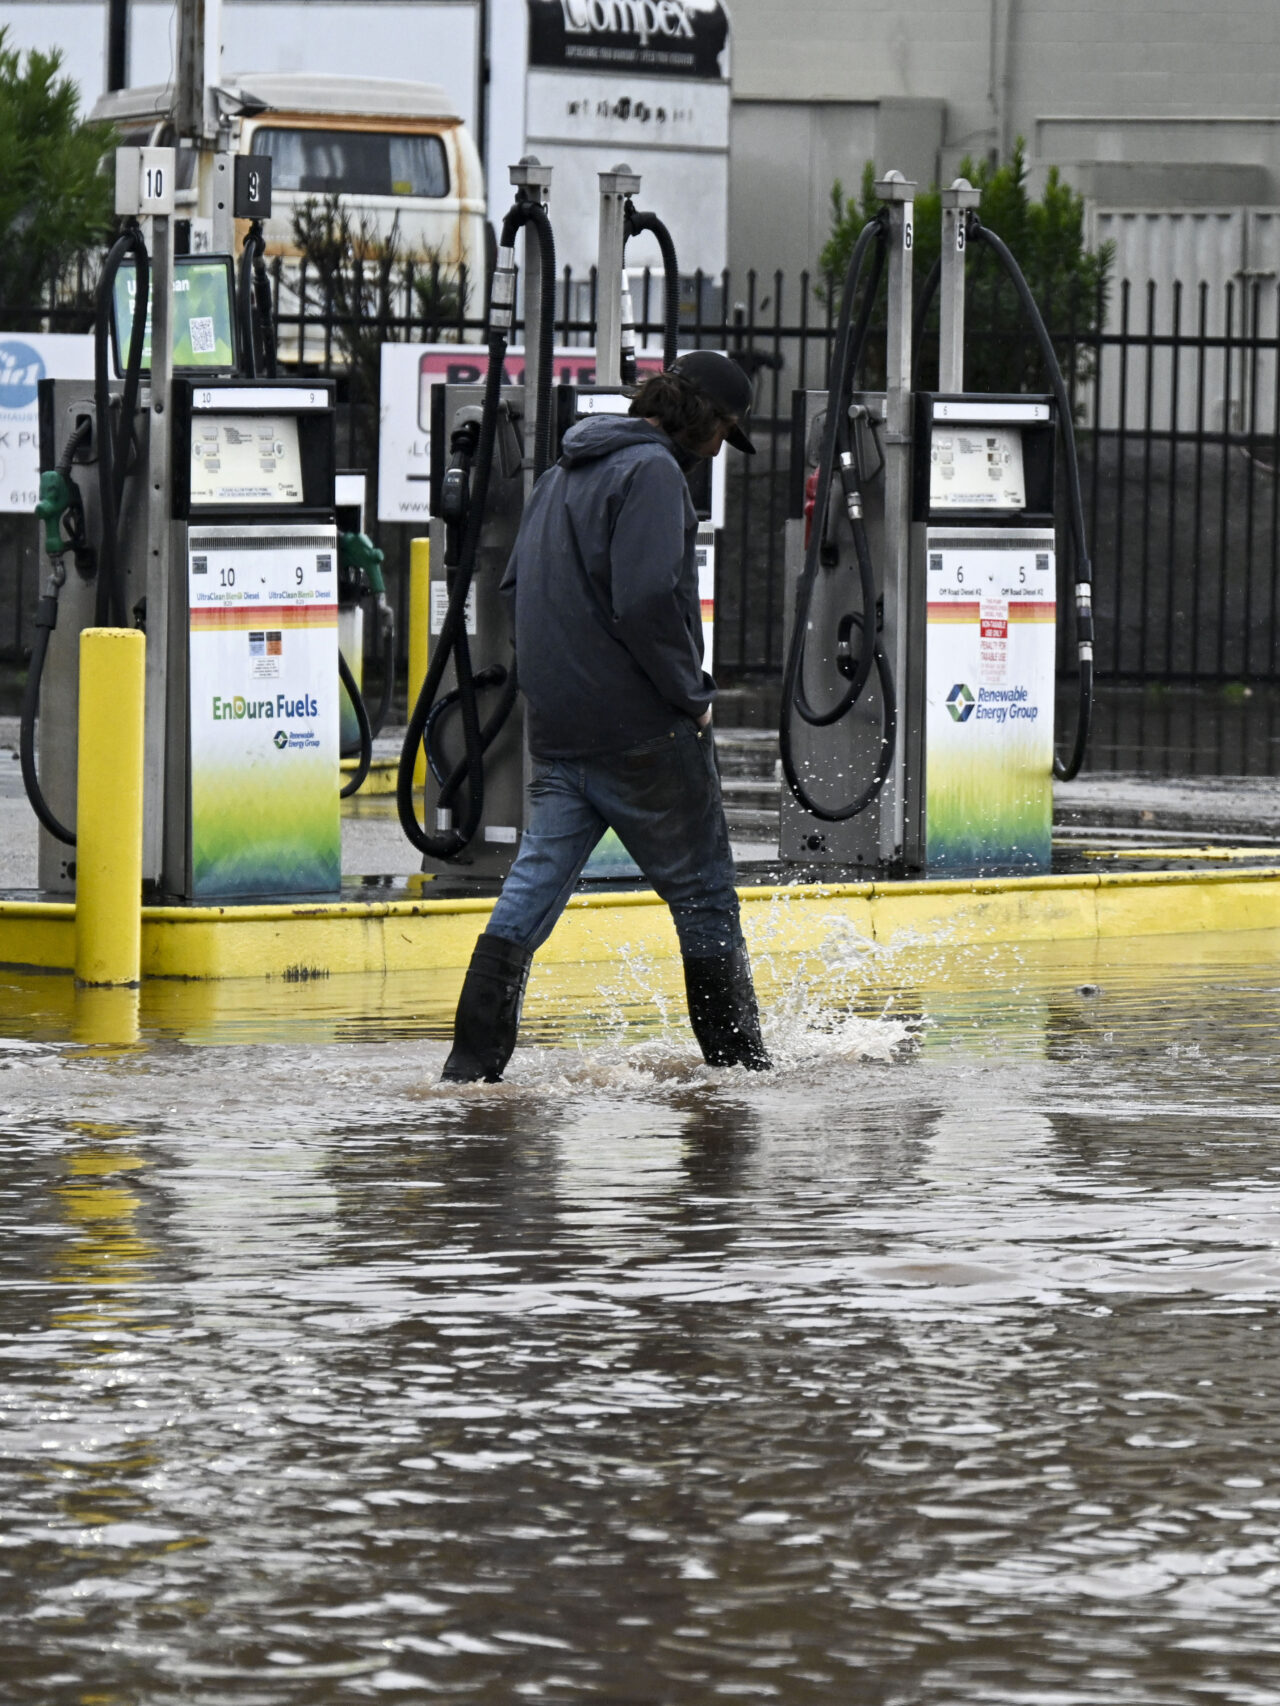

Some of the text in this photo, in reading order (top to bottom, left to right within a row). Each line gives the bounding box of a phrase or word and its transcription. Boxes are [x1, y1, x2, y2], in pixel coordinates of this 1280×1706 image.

[146, 169, 163, 198] 10
[249, 172, 259, 201] 9
[905, 222, 912, 249] 6
[957, 223, 965, 250] 5
[0, 353, 40, 385] ir1
[202, 392, 211, 404] 10
[309, 392, 315, 404] 9
[588, 397, 594, 409] 8
[220, 567, 235, 587] 10
[295, 566, 304, 586] 9
[957, 566, 964, 584] 6
[1019, 566, 1026, 584] 5
[196, 591, 226, 601] UltraClean
[244, 591, 260, 600] Diesel
[268, 591, 298, 600] UltraClean
[315, 590, 331, 599] Diesel
[978, 687, 1028, 703] Renewable
[212, 693, 318, 721] EnDura Fuels
[976, 703, 1038, 724] Energy Group
[288, 739, 320, 749] Energy Group
[289, 731, 315, 740] Renewable
